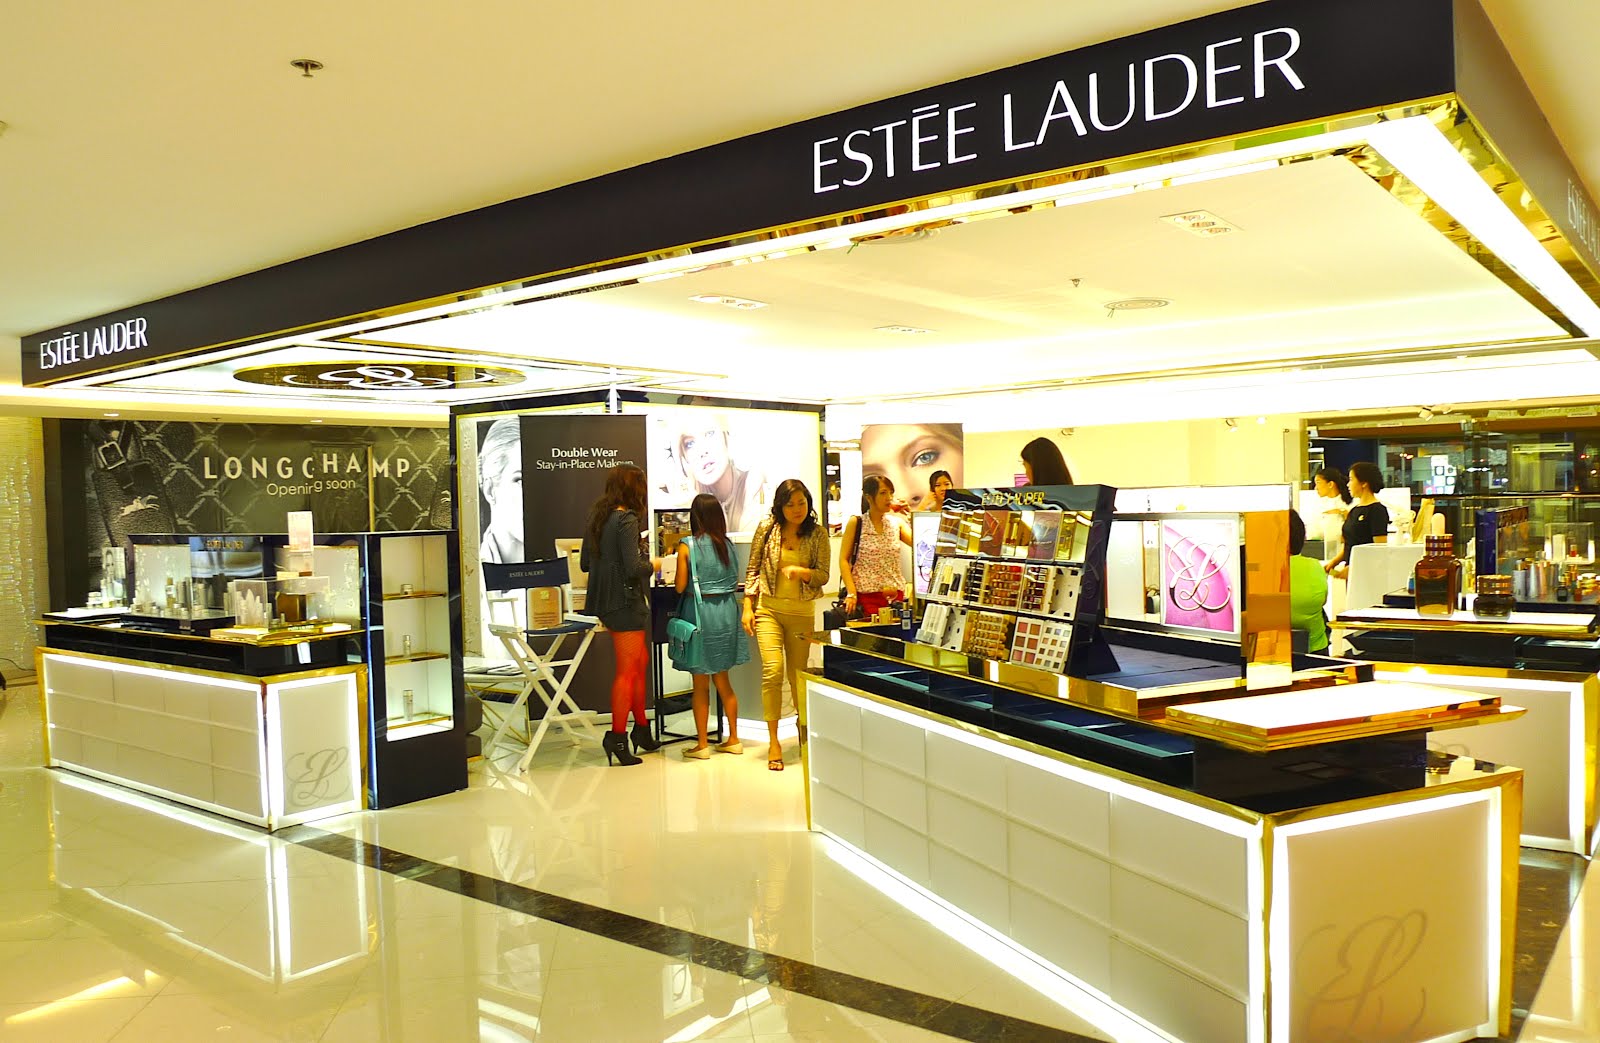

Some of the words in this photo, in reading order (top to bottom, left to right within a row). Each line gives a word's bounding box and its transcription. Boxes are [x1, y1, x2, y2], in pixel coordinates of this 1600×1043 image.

[1003, 26, 1306, 153] LAUDER
[83, 317, 149, 360] LAUDER
[551, 447, 589, 459] Double
[590, 447, 618, 458] Wear
[204, 452, 410, 479] LONGCHAMP
[536, 459, 596, 472] Stay-in-Place
[325, 477, 357, 490] soon
